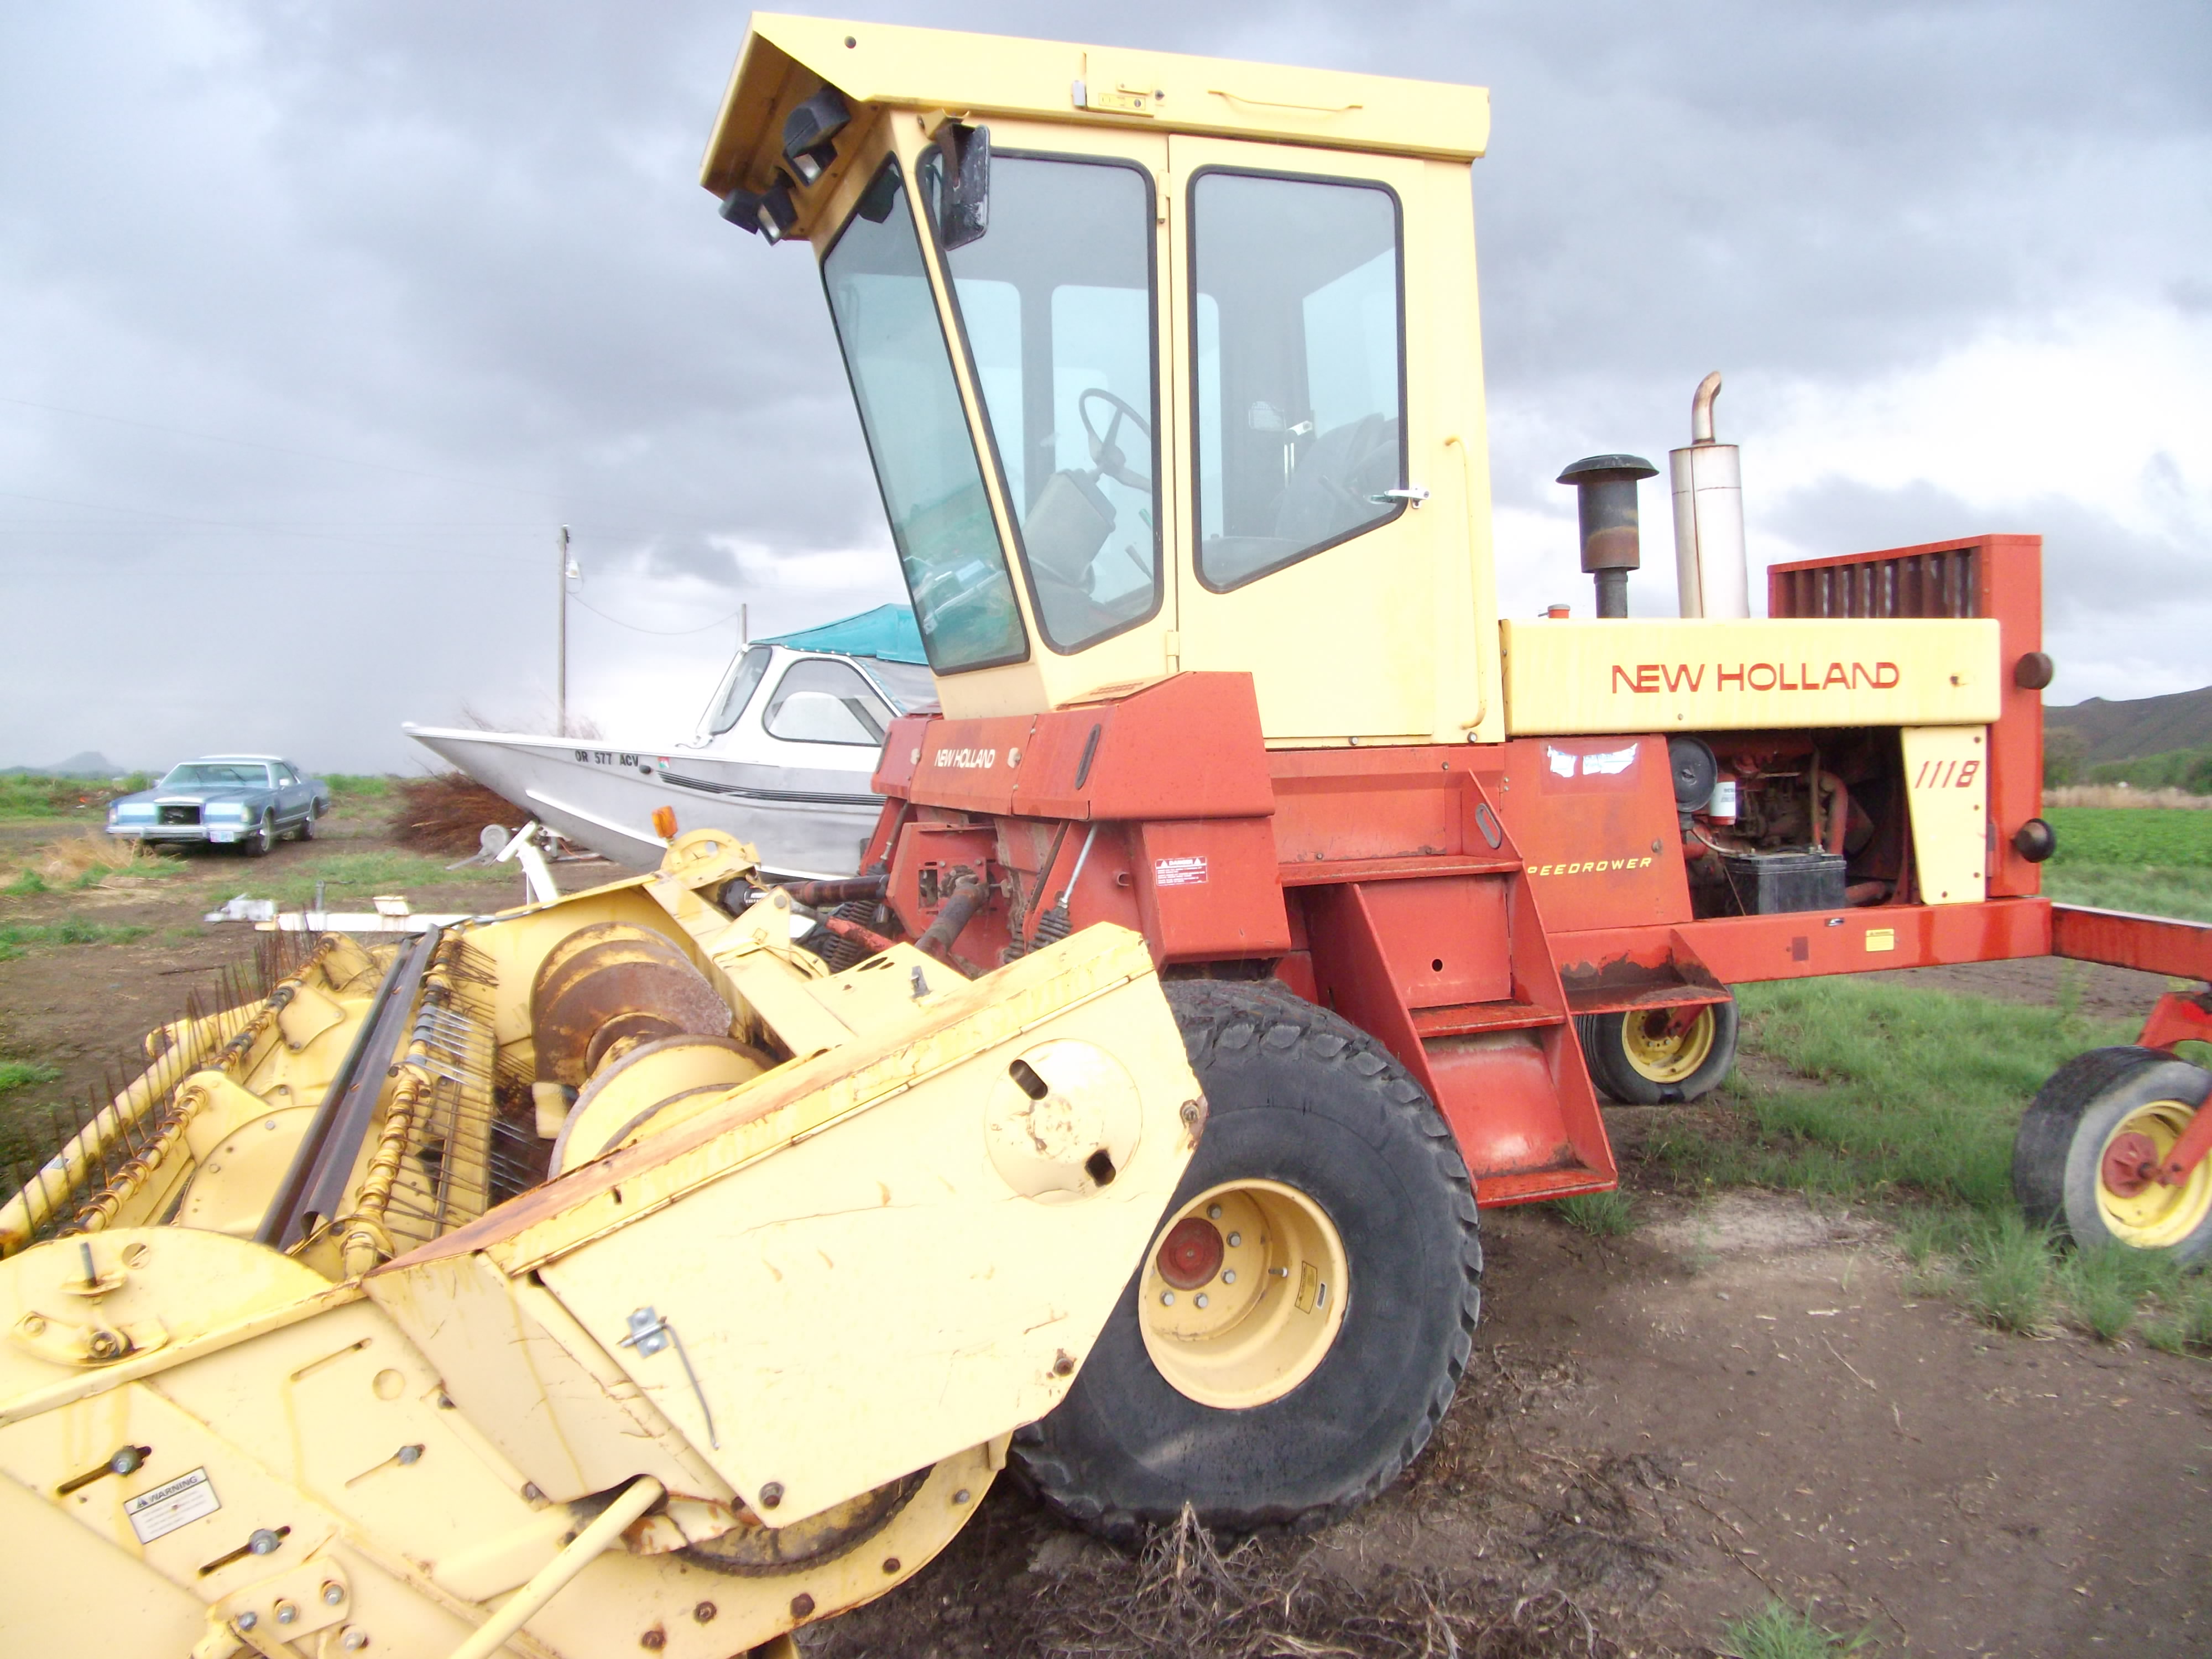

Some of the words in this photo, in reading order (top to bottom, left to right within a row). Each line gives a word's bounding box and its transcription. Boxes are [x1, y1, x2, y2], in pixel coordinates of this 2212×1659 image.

[1612, 664, 1705, 693] NEW
[1717, 662, 1900, 692] HOLLAND
[575, 749, 589, 763] OR
[594, 752, 612, 765] 577
[619, 753, 639, 767] ACV
[933, 749, 956, 767] NEW
[953, 748, 996, 769] HOLLAND
[1914, 760, 1981, 789] 1118
[1527, 857, 1652, 876] PEEDROWER
[148, 1475, 198, 1503] WARNING
